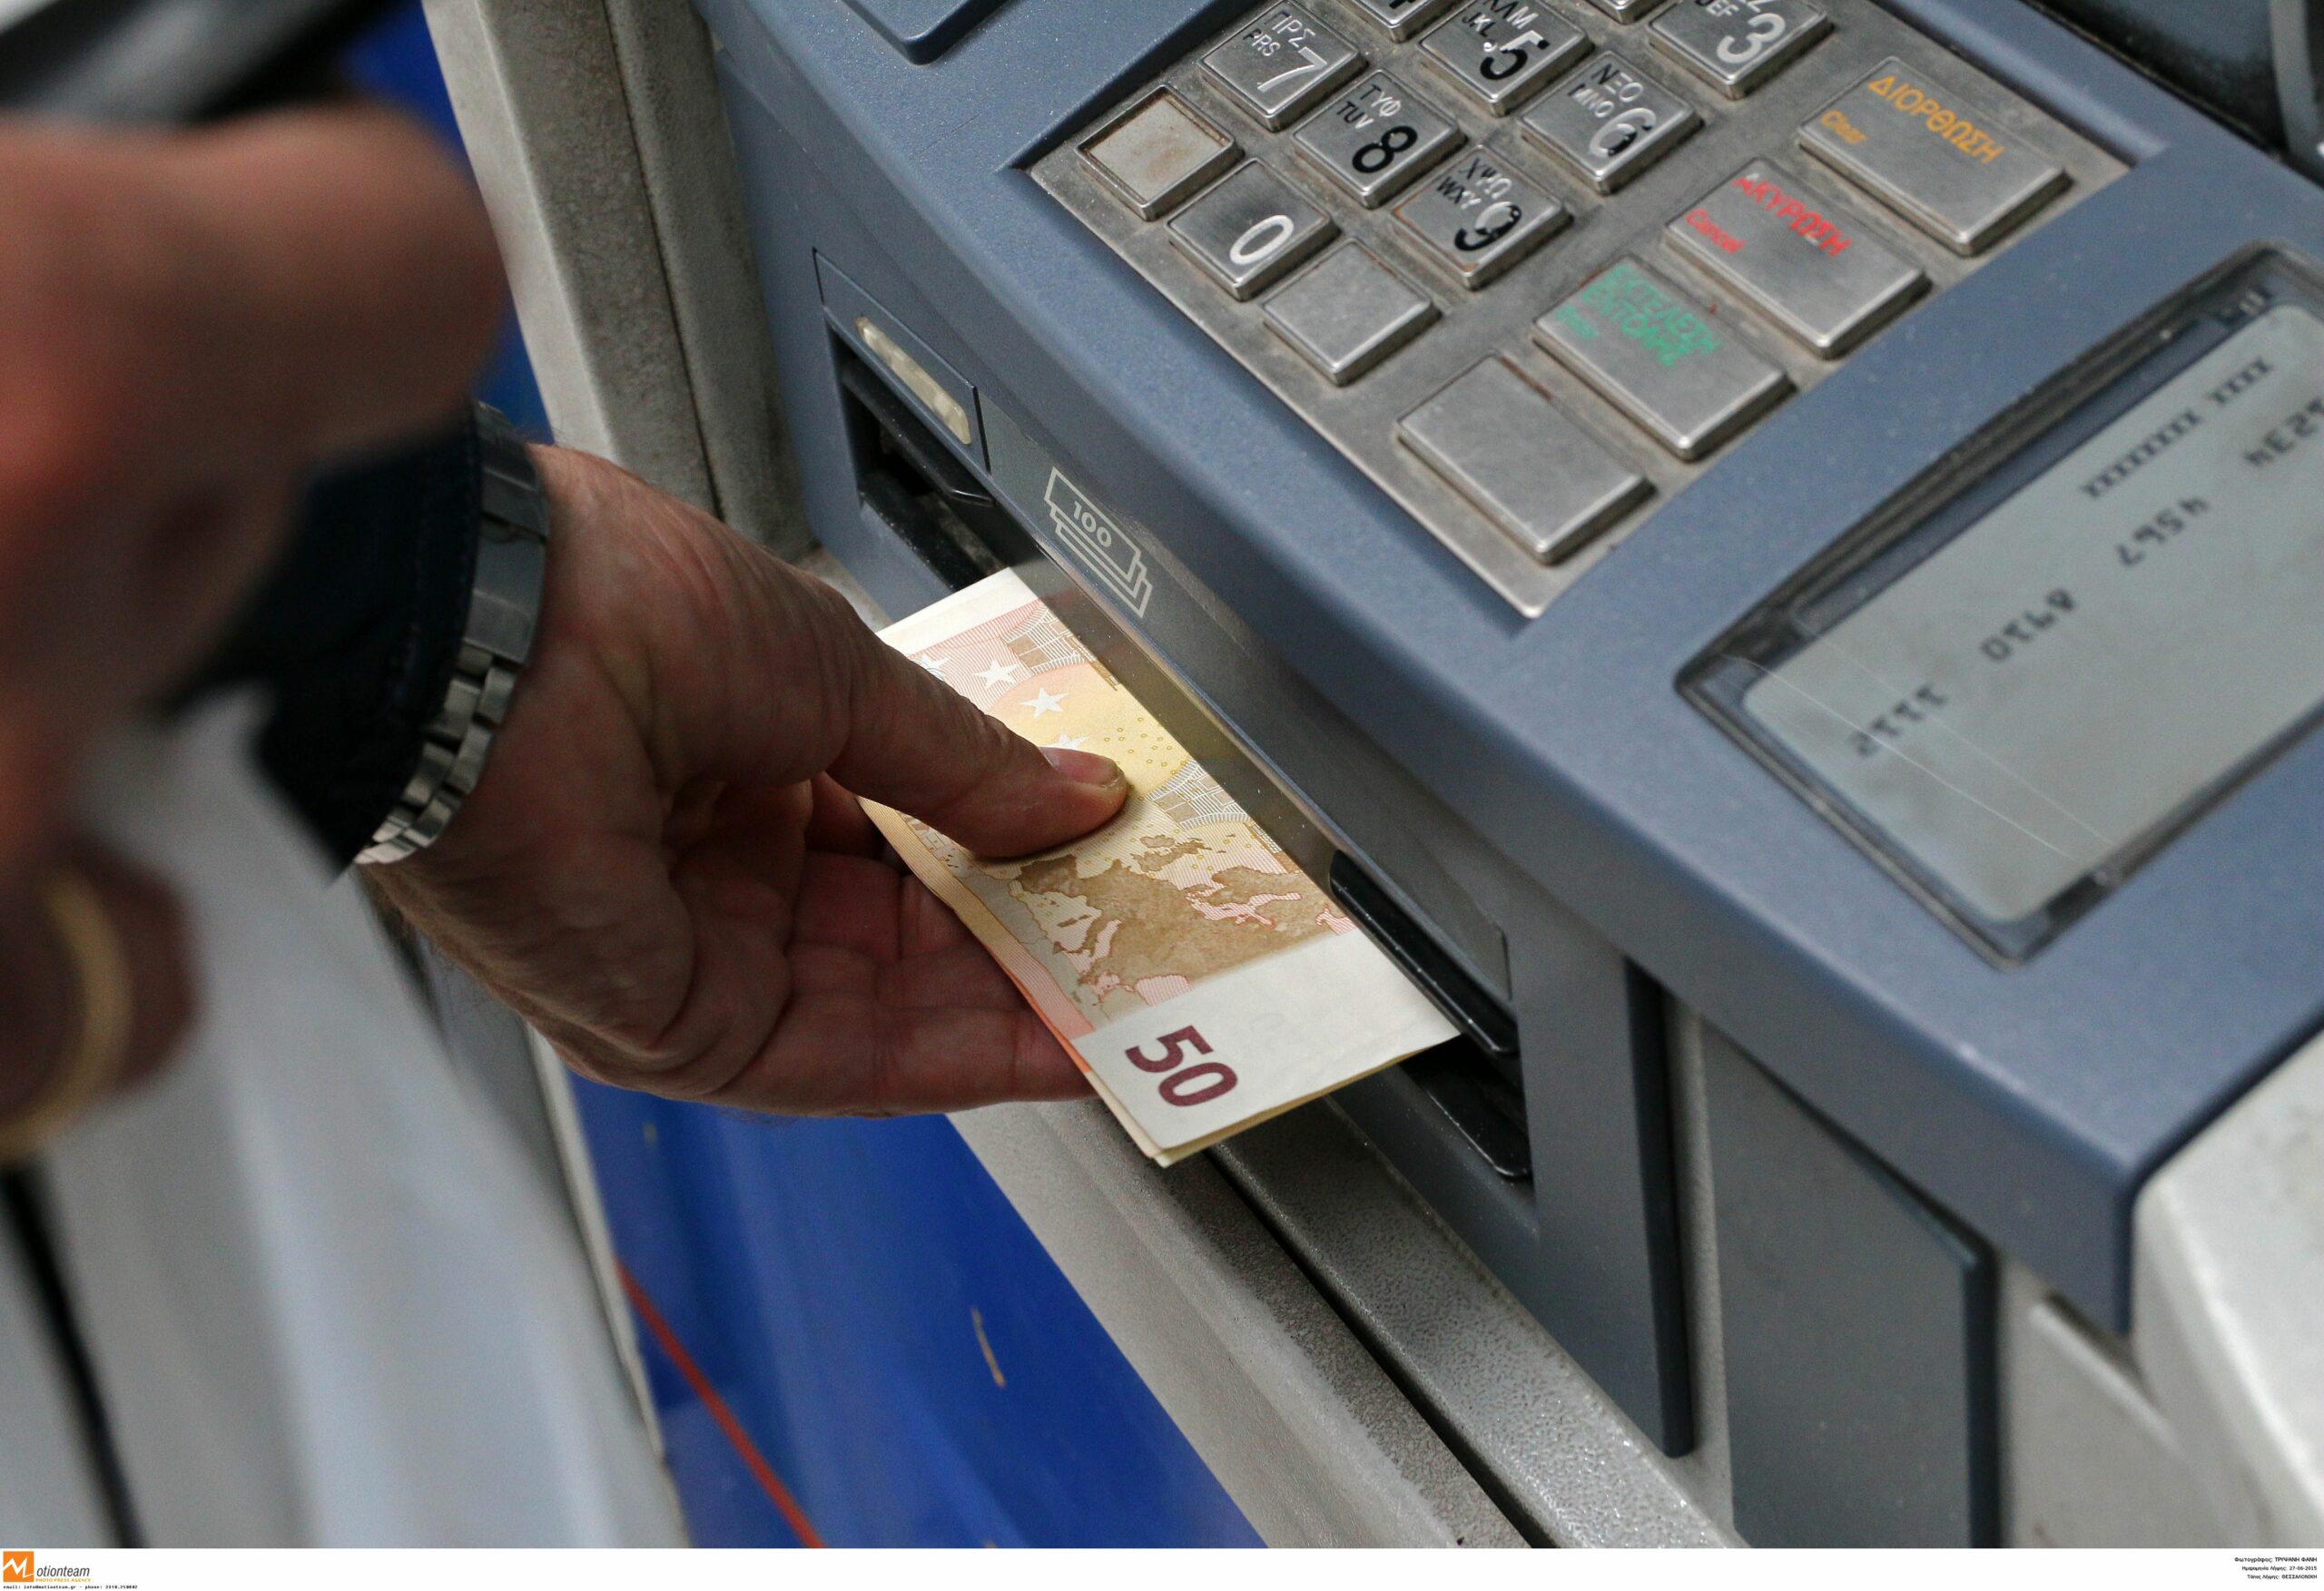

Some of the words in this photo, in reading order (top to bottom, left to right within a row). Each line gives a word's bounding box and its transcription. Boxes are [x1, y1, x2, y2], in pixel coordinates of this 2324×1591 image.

[1243, 28, 1281, 57] PRS
[1462, 12, 1497, 37] JKL
[1717, 13, 1787, 64] 3
[1256, 46, 1328, 93] 7
[1481, 30, 1551, 81] 5
[1336, 101, 1374, 129] TUV
[1590, 107, 1658, 158] 6
[1867, 74, 2006, 164] ΔΙΟΡΘΩΣΗ
[1352, 125, 1419, 174] 8
[1229, 214, 1295, 265] 0
[1453, 201, 1522, 251] 9
[1731, 172, 1854, 258] ΑΚΥΡΩΣΗ
[1073, 500, 1112, 548] 100
[2113, 492, 2211, 569] 4567
[1980, 585, 2079, 664] 8910
[1125, 1025, 1238, 1106] 50
